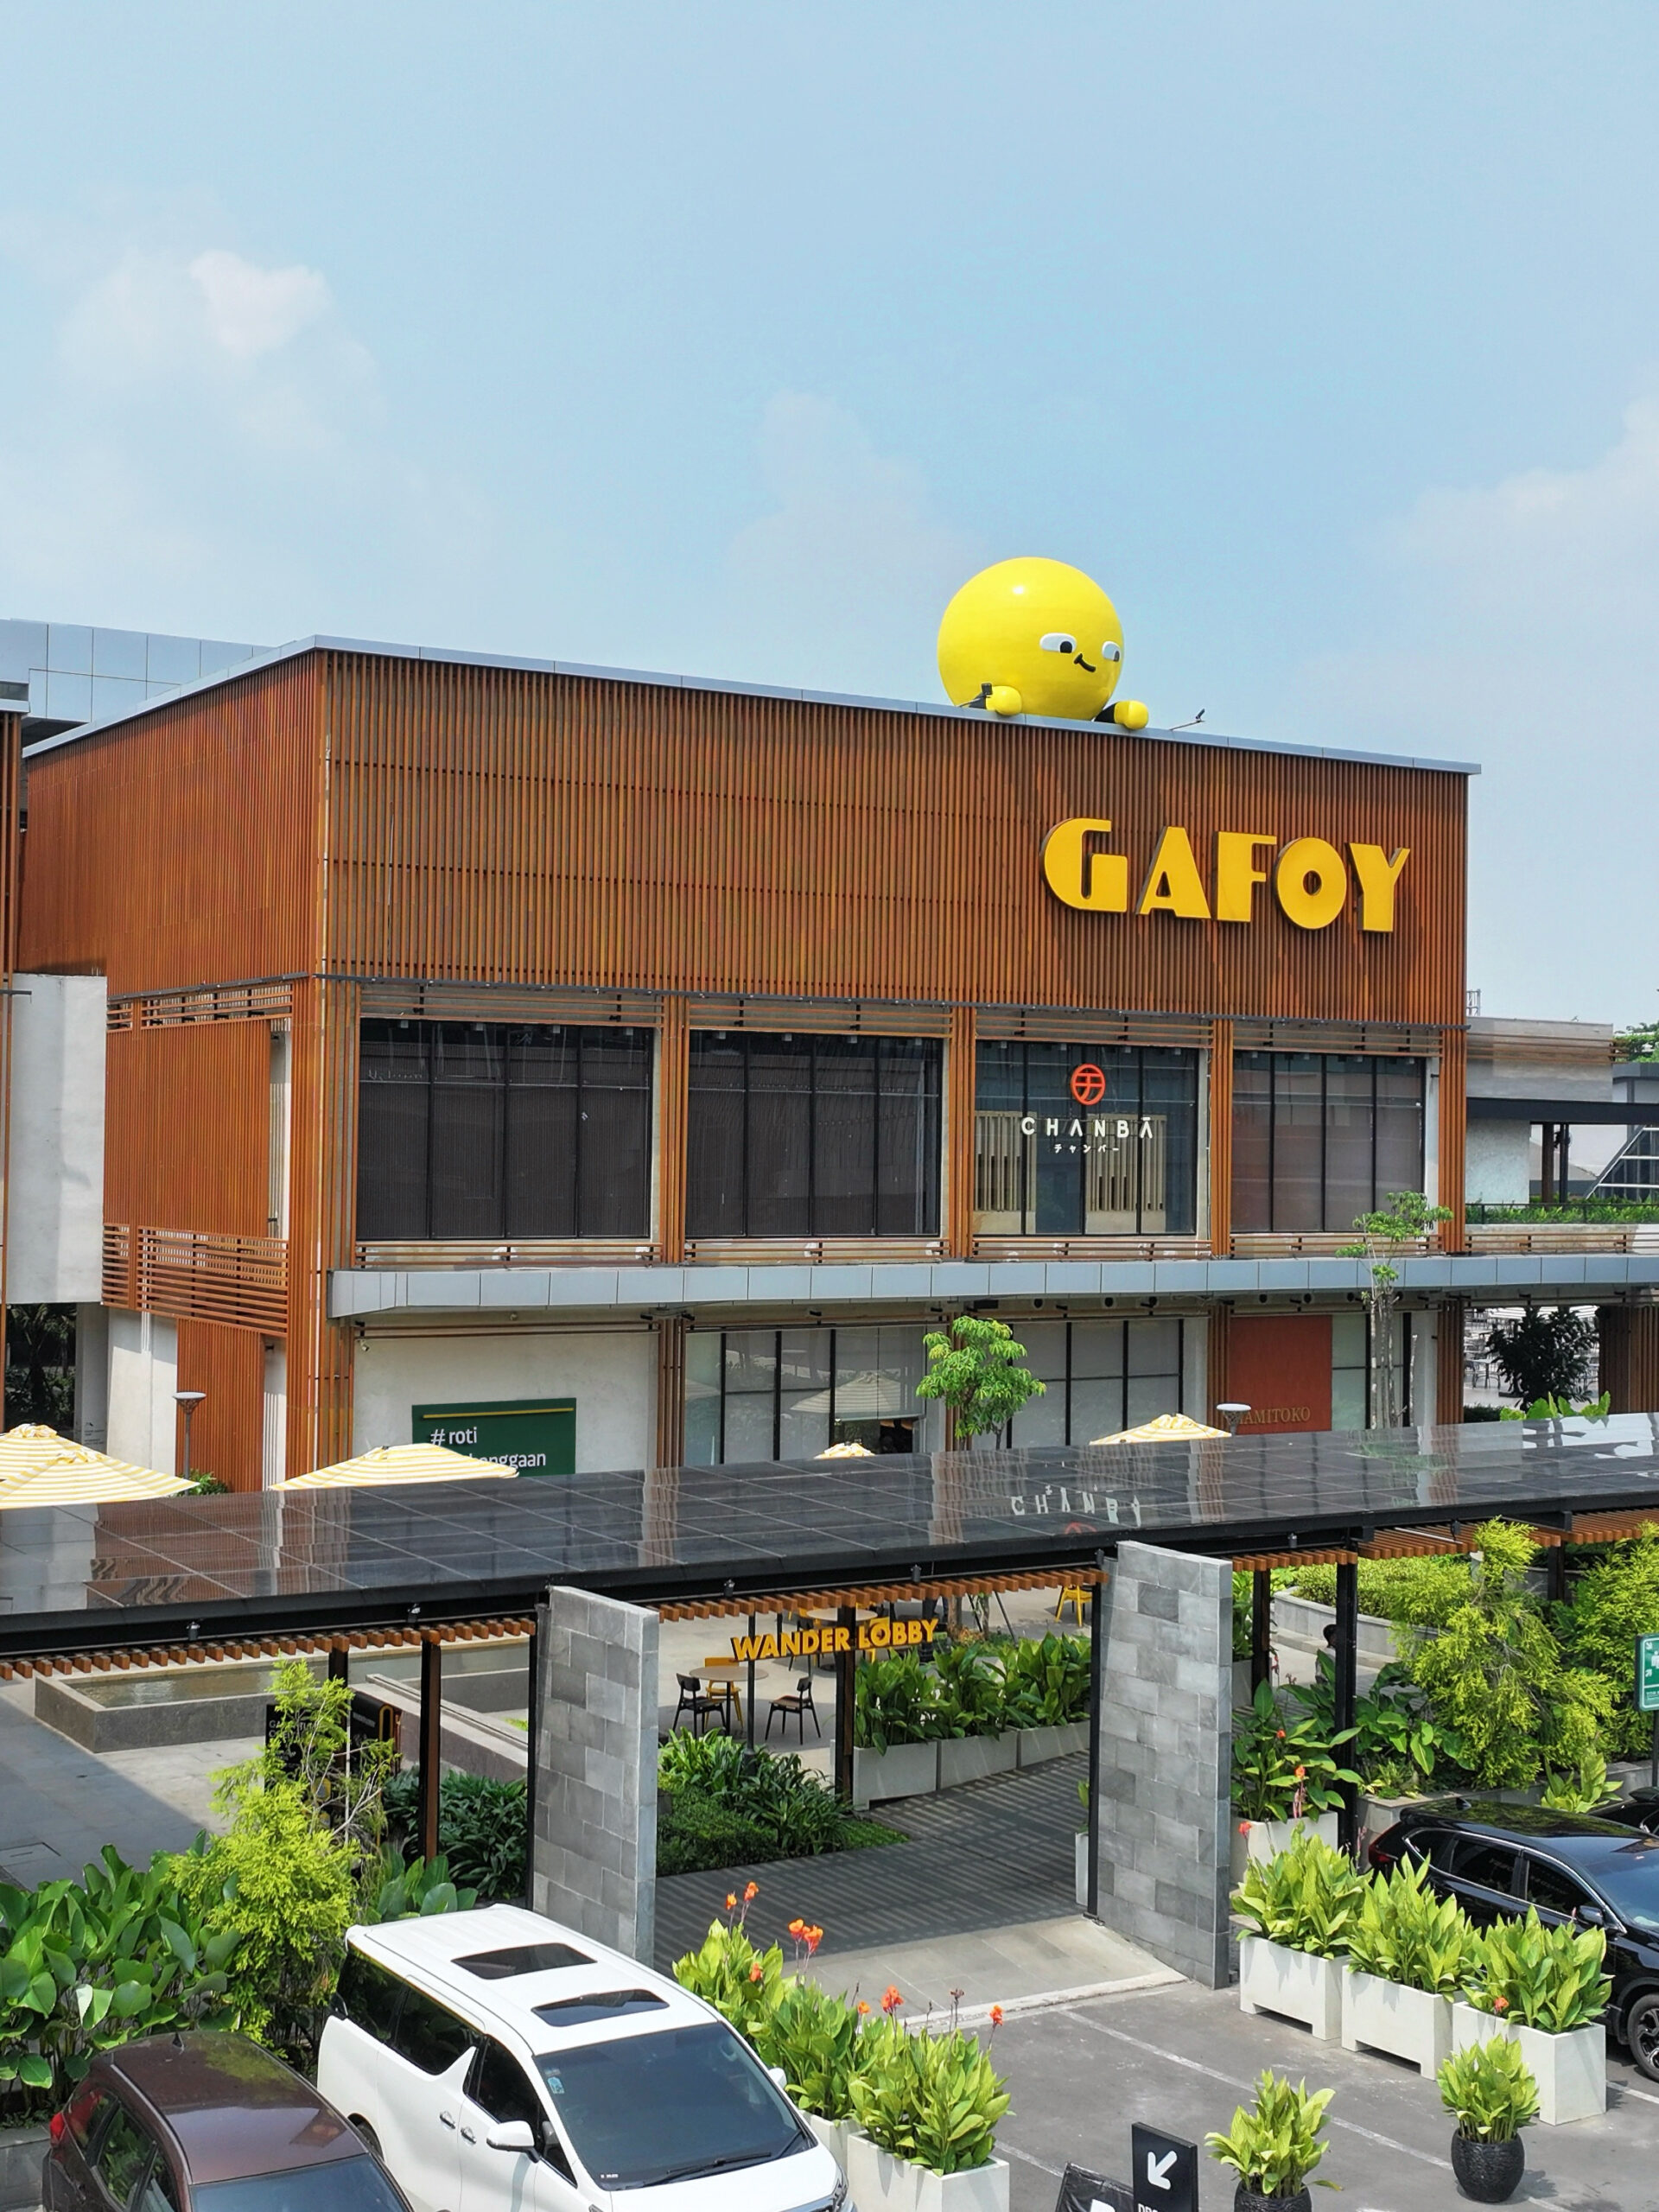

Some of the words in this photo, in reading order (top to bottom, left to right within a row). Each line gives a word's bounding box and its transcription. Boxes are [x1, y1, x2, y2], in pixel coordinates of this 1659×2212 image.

[1039, 817, 1410, 931] GAFOY
[731, 1627, 850, 1661] WANDER
[858, 1618, 938, 1648] LOBBY
